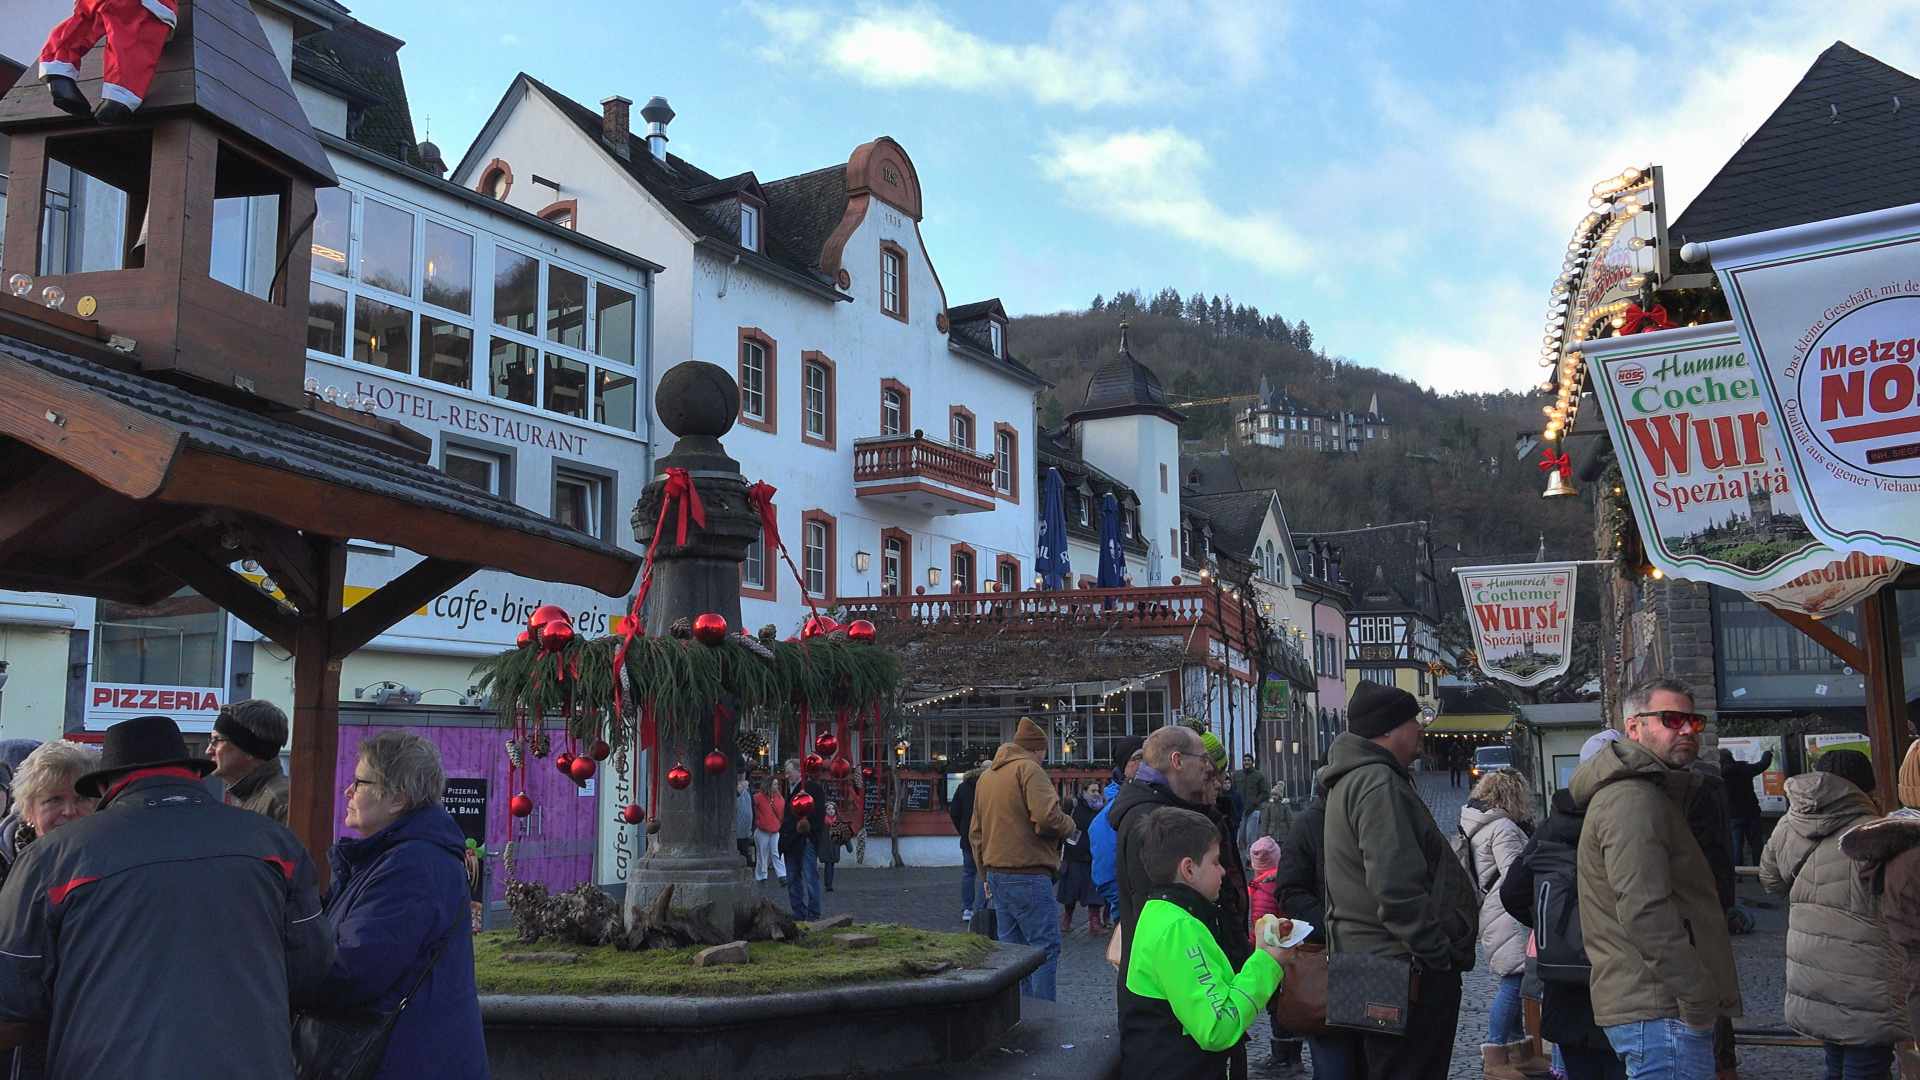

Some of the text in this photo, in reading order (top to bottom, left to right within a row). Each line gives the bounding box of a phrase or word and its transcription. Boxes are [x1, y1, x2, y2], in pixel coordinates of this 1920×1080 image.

[1784, 279, 1920, 379] Das kleine Geschäft, mit de
[1652, 352, 1750, 382] Humme
[1820, 338, 1920, 371] Metzg
[1820, 363, 1920, 422] NO
[356, 381, 588, 455] HOTEL-RESTAURANT
[1626, 411, 1769, 477] Wur
[1784, 398, 1920, 492] Qualität aus eigener Viehau
[1652, 467, 1790, 513] Spezialitä
[434, 589, 487, 629] cafe
[578, 605, 607, 633] eis
[1477, 589, 1560, 603] Cochemer
[1483, 631, 1561, 650] Spezialitäten
[93, 687, 220, 711] PIZZERIA
